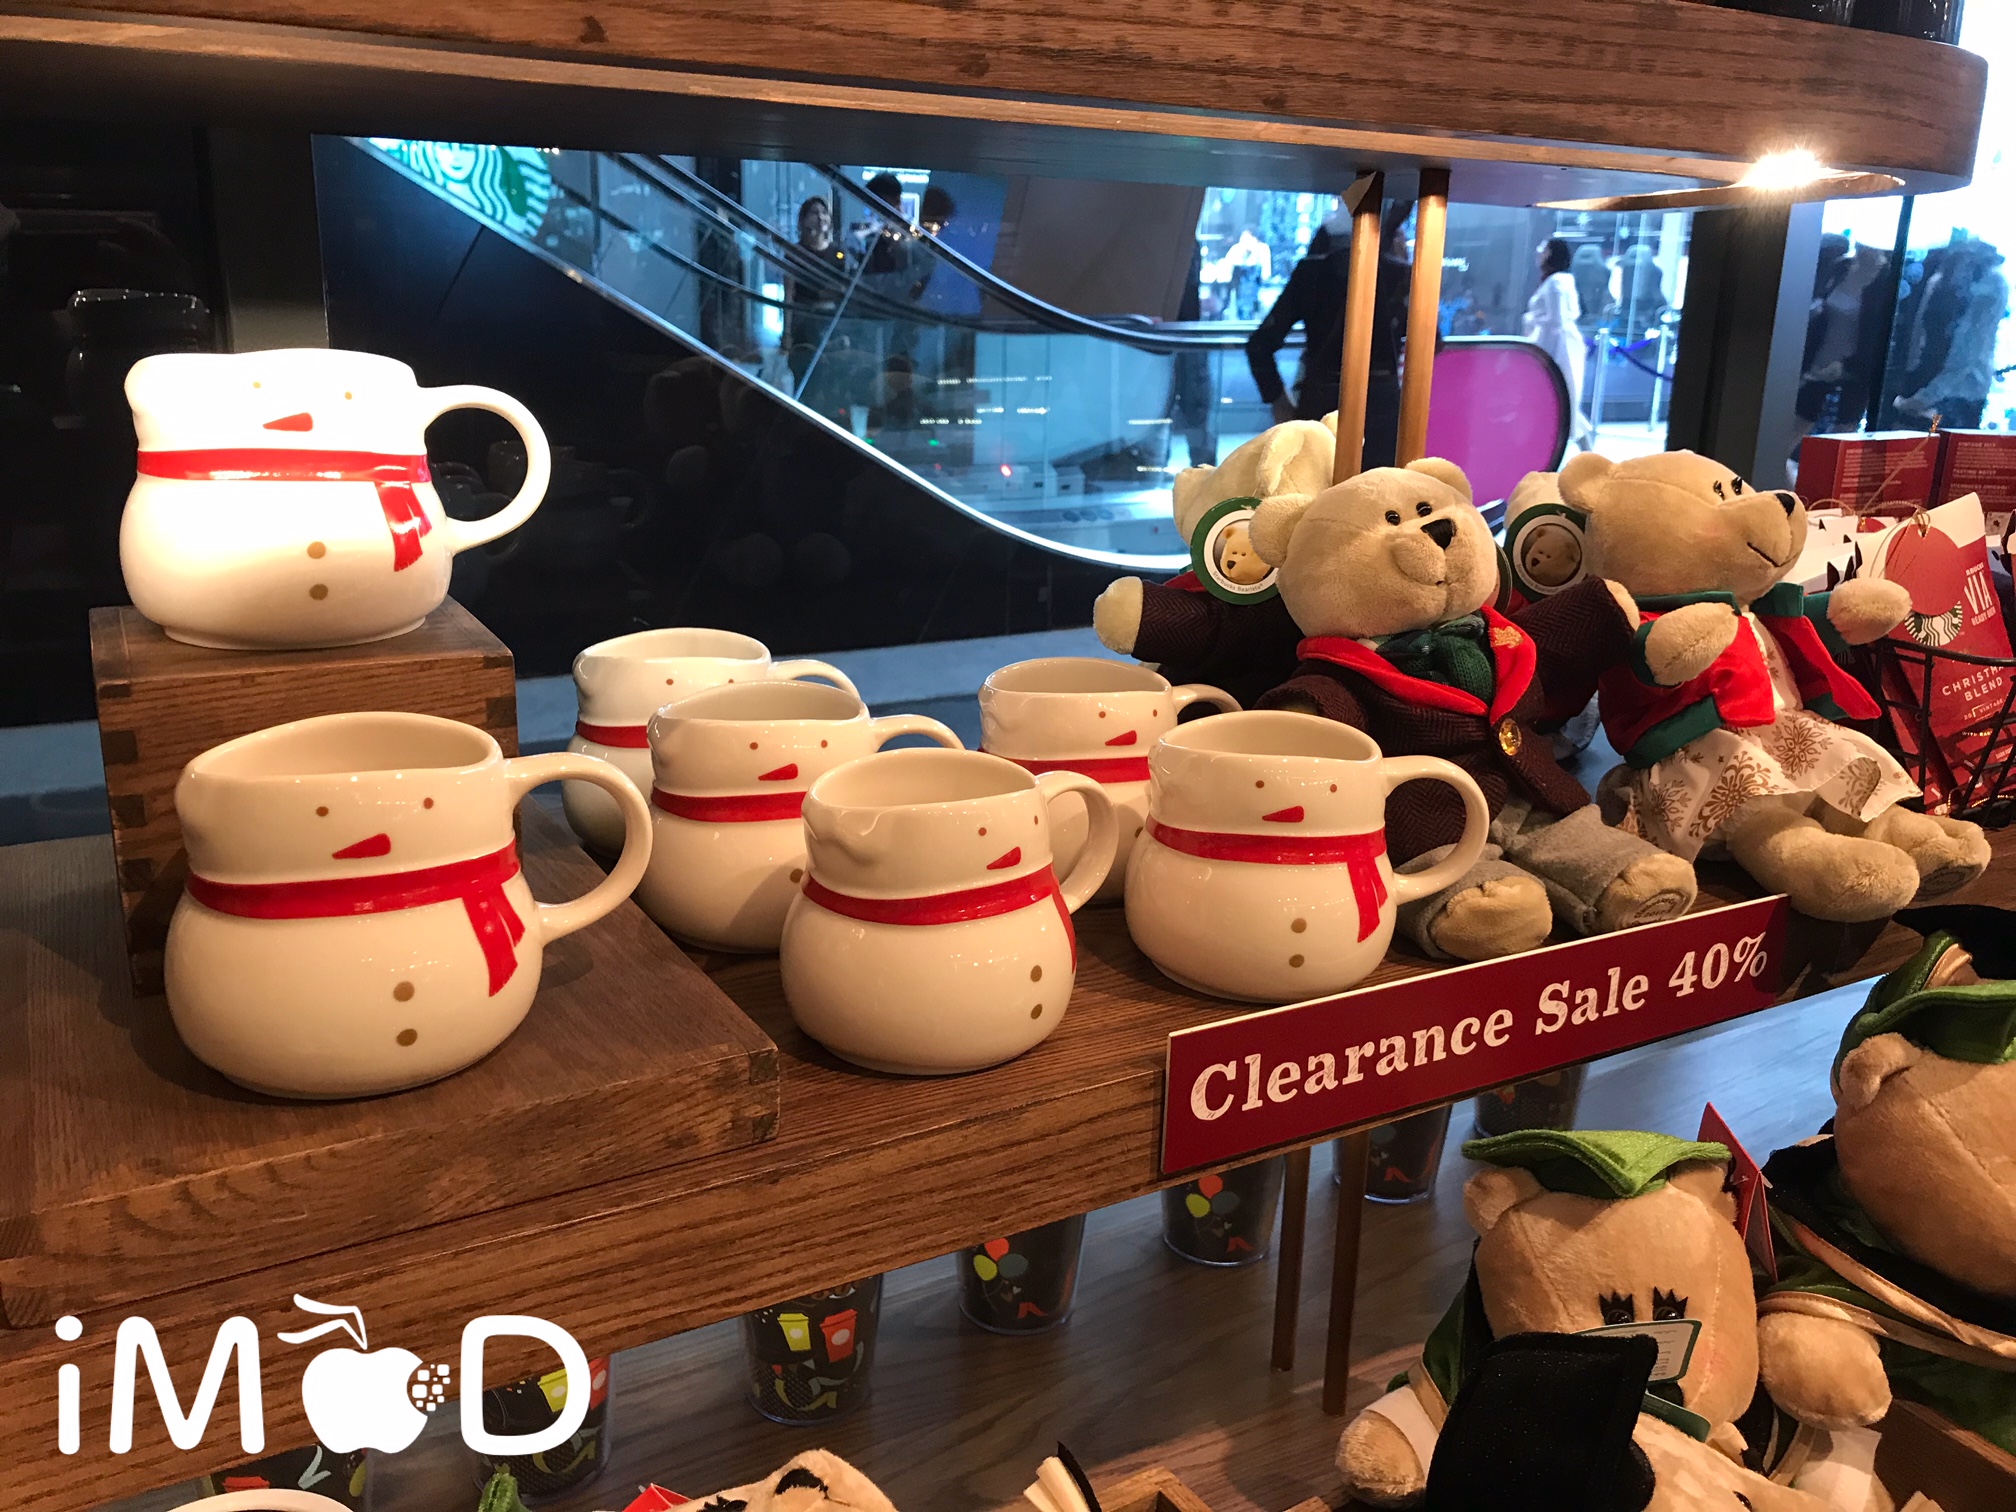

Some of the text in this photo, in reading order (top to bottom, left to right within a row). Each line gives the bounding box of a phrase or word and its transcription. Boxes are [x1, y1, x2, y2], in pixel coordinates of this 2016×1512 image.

[1964, 571, 1993, 615] VIA
[1964, 676, 2003, 701] BLEND
[1191, 931, 1768, 1122] Clearance Sale 40%
